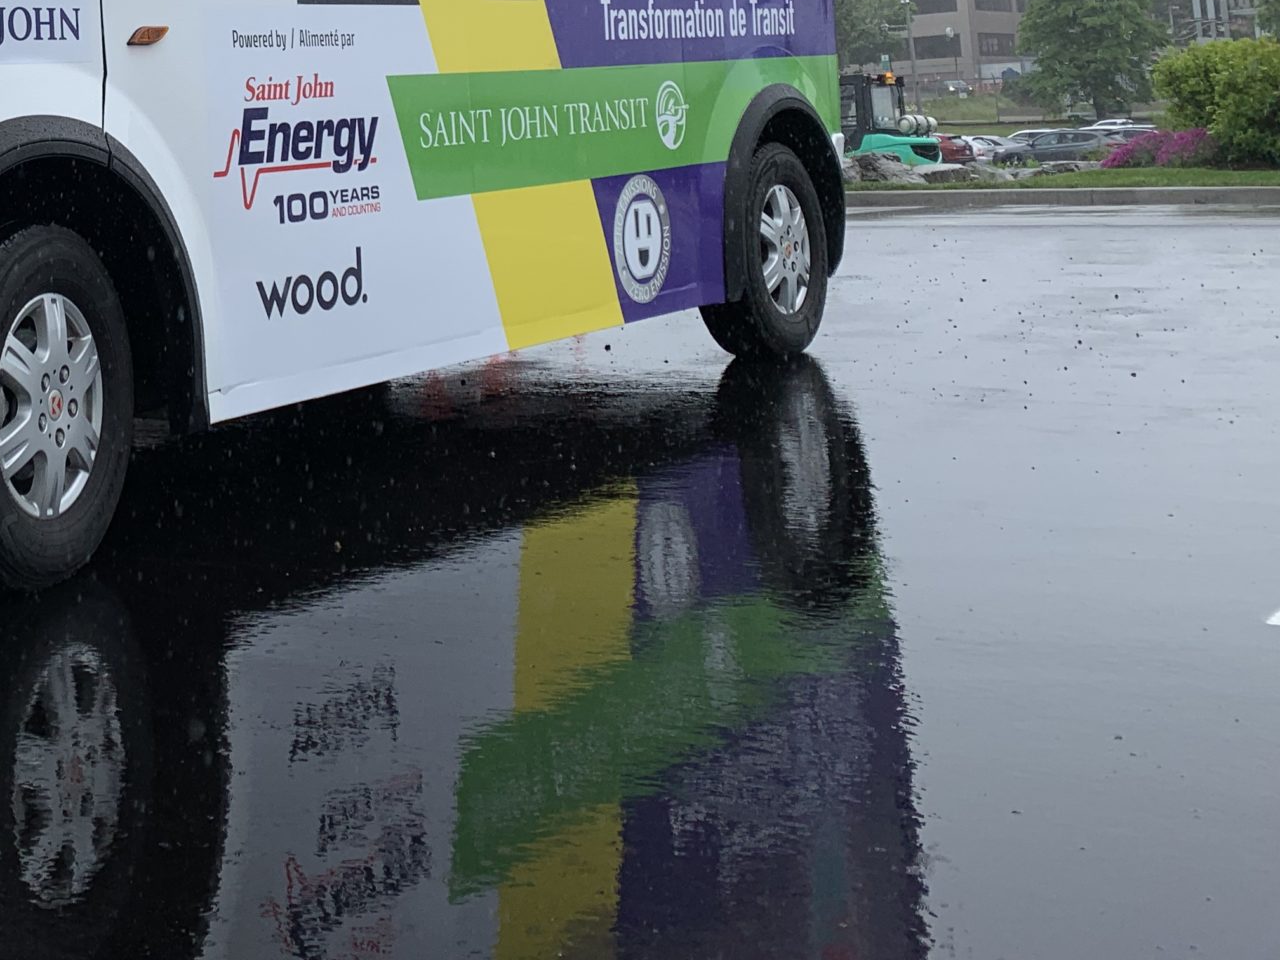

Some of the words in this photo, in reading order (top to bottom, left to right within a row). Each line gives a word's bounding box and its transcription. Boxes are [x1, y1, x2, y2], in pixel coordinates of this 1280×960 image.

[232, 29, 273, 48] Powered
[275, 30, 287, 51] by
[299, 29, 339, 47] Alimenté
[341, 33, 355, 49] par
[244, 76, 291, 102] Saint
[291, 73, 334, 105] John
[238, 107, 379, 174] Energy
[419, 109, 492, 149] SAINT
[499, 105, 558, 146] JOHN
[564, 97, 648, 136] TRANSIT
[273, 191, 329, 224] 100
[329, 185, 380, 204] YEARS
[332, 207, 346, 218] AND
[347, 202, 381, 216] COUNTING
[630, 281, 650, 301] ZERO
[650, 226, 670, 296] EMISSION
